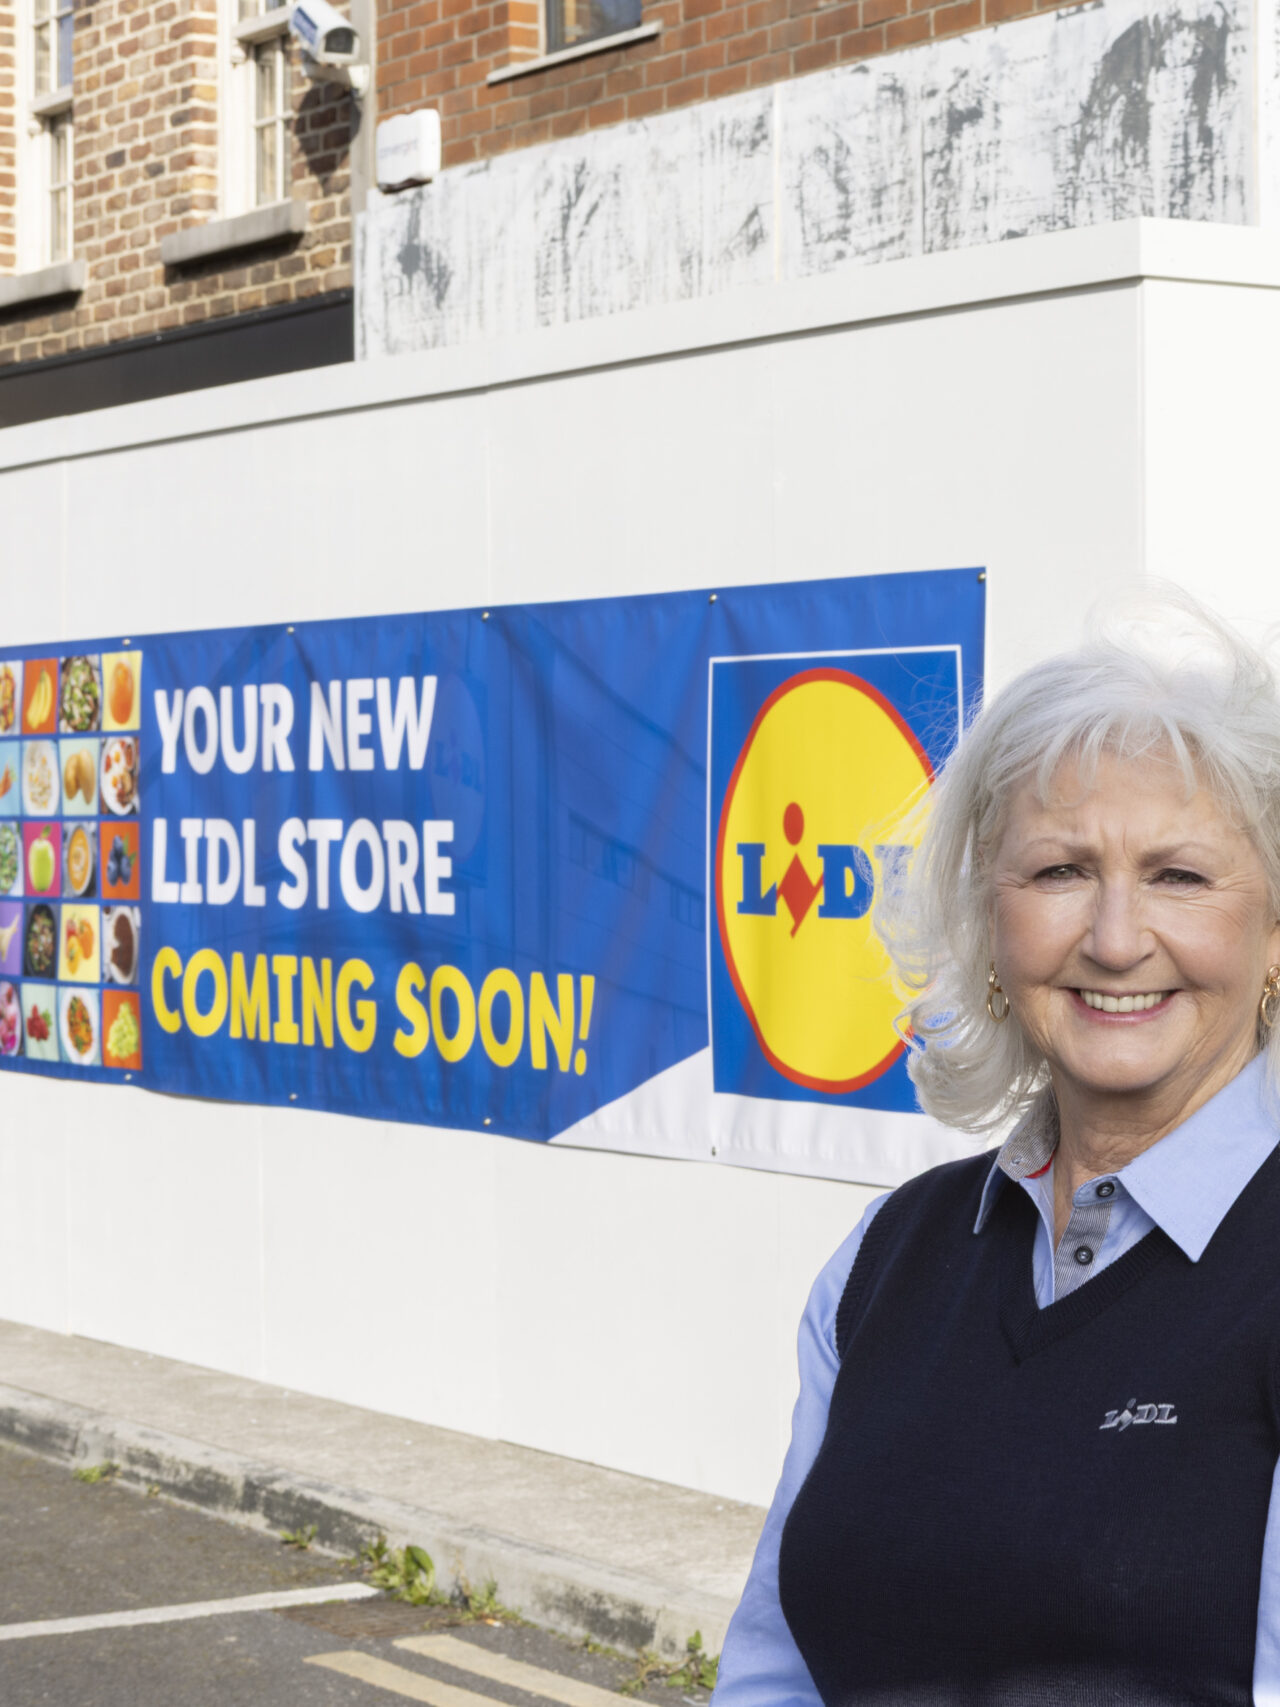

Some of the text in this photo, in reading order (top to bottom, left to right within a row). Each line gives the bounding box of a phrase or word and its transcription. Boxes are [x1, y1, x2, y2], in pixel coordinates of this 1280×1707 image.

[154, 675, 438, 775] YOUR NEW
[152, 817, 456, 915] LIDL STORE
[151, 946, 596, 1076] COMING SOON!
